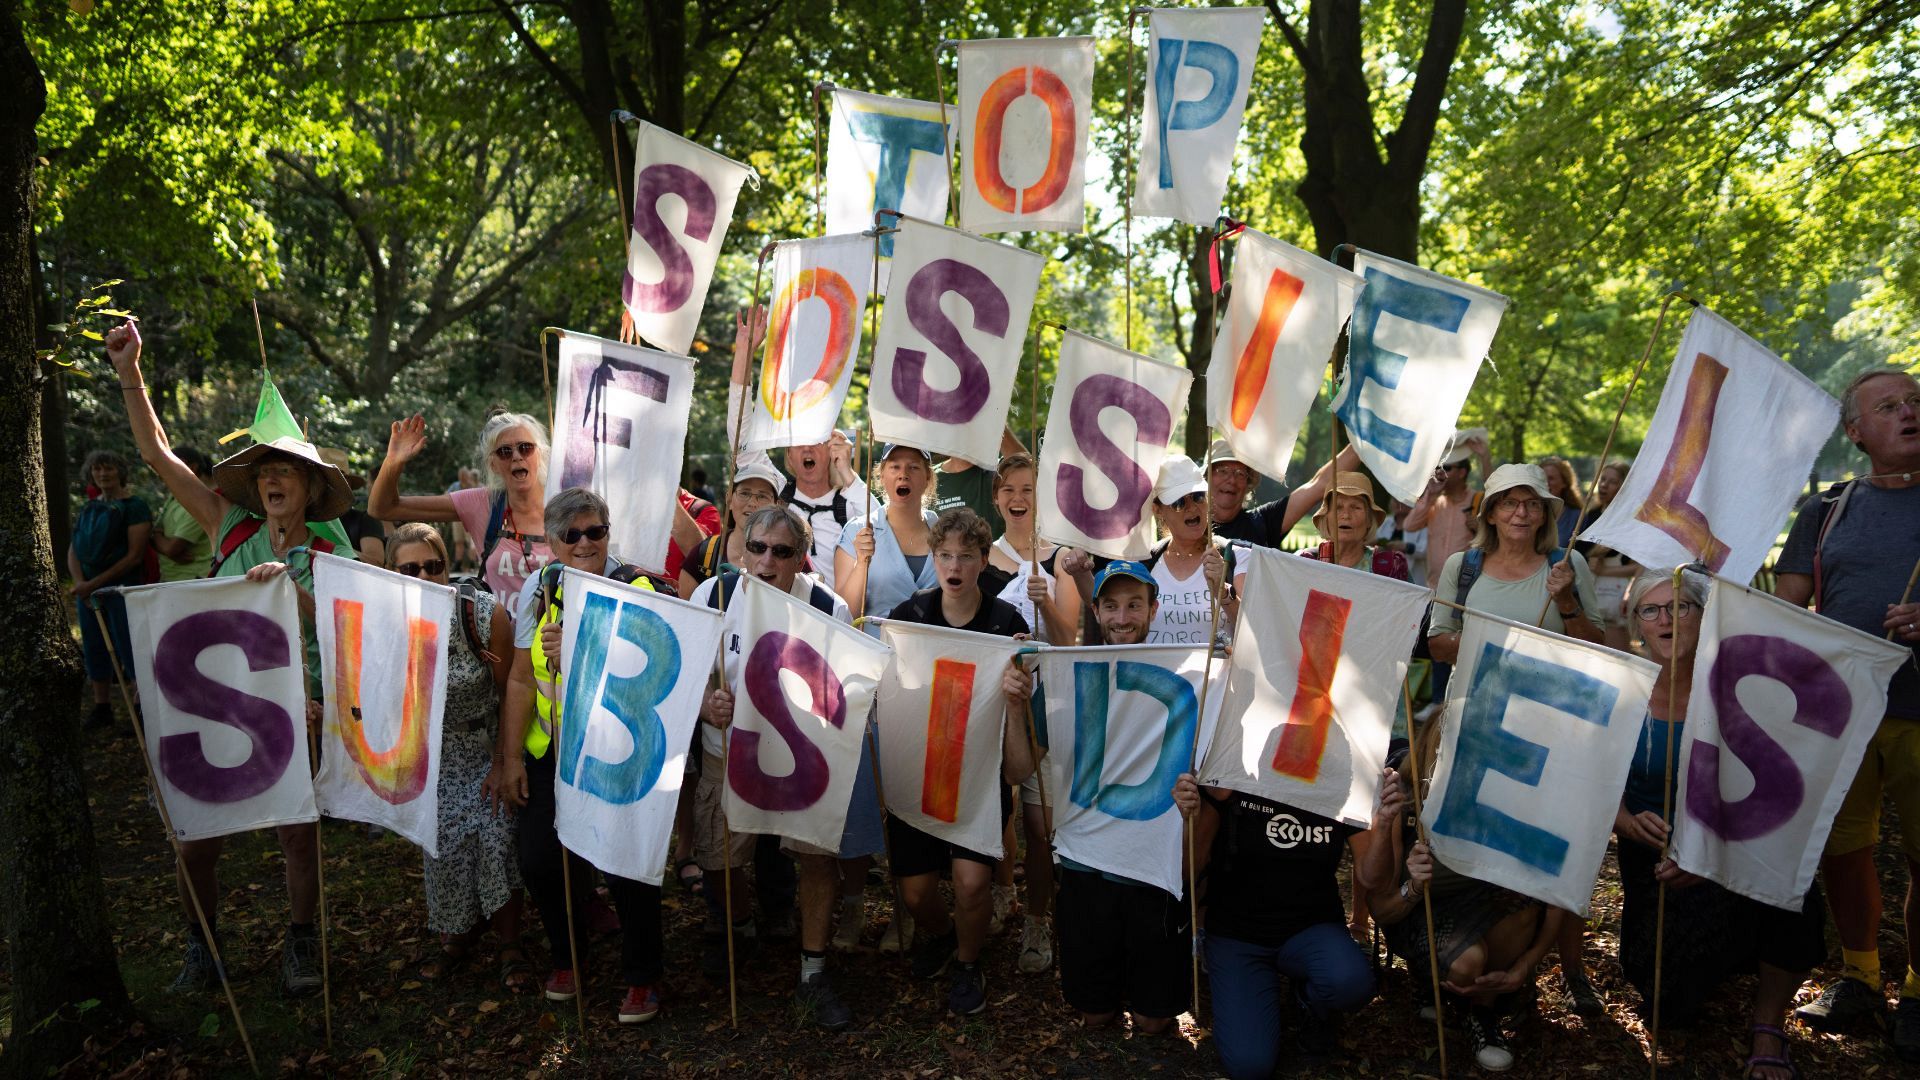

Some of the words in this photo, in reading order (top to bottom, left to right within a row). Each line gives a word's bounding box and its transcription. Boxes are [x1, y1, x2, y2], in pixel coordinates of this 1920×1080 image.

[498, 550, 549, 579] ACT
[156, 589, 1853, 877] SUBSIDIES
[1248, 802, 1261, 811] BEN
[1262, 805, 1274, 814] EEN
[1265, 820, 1333, 845] EKOIST
